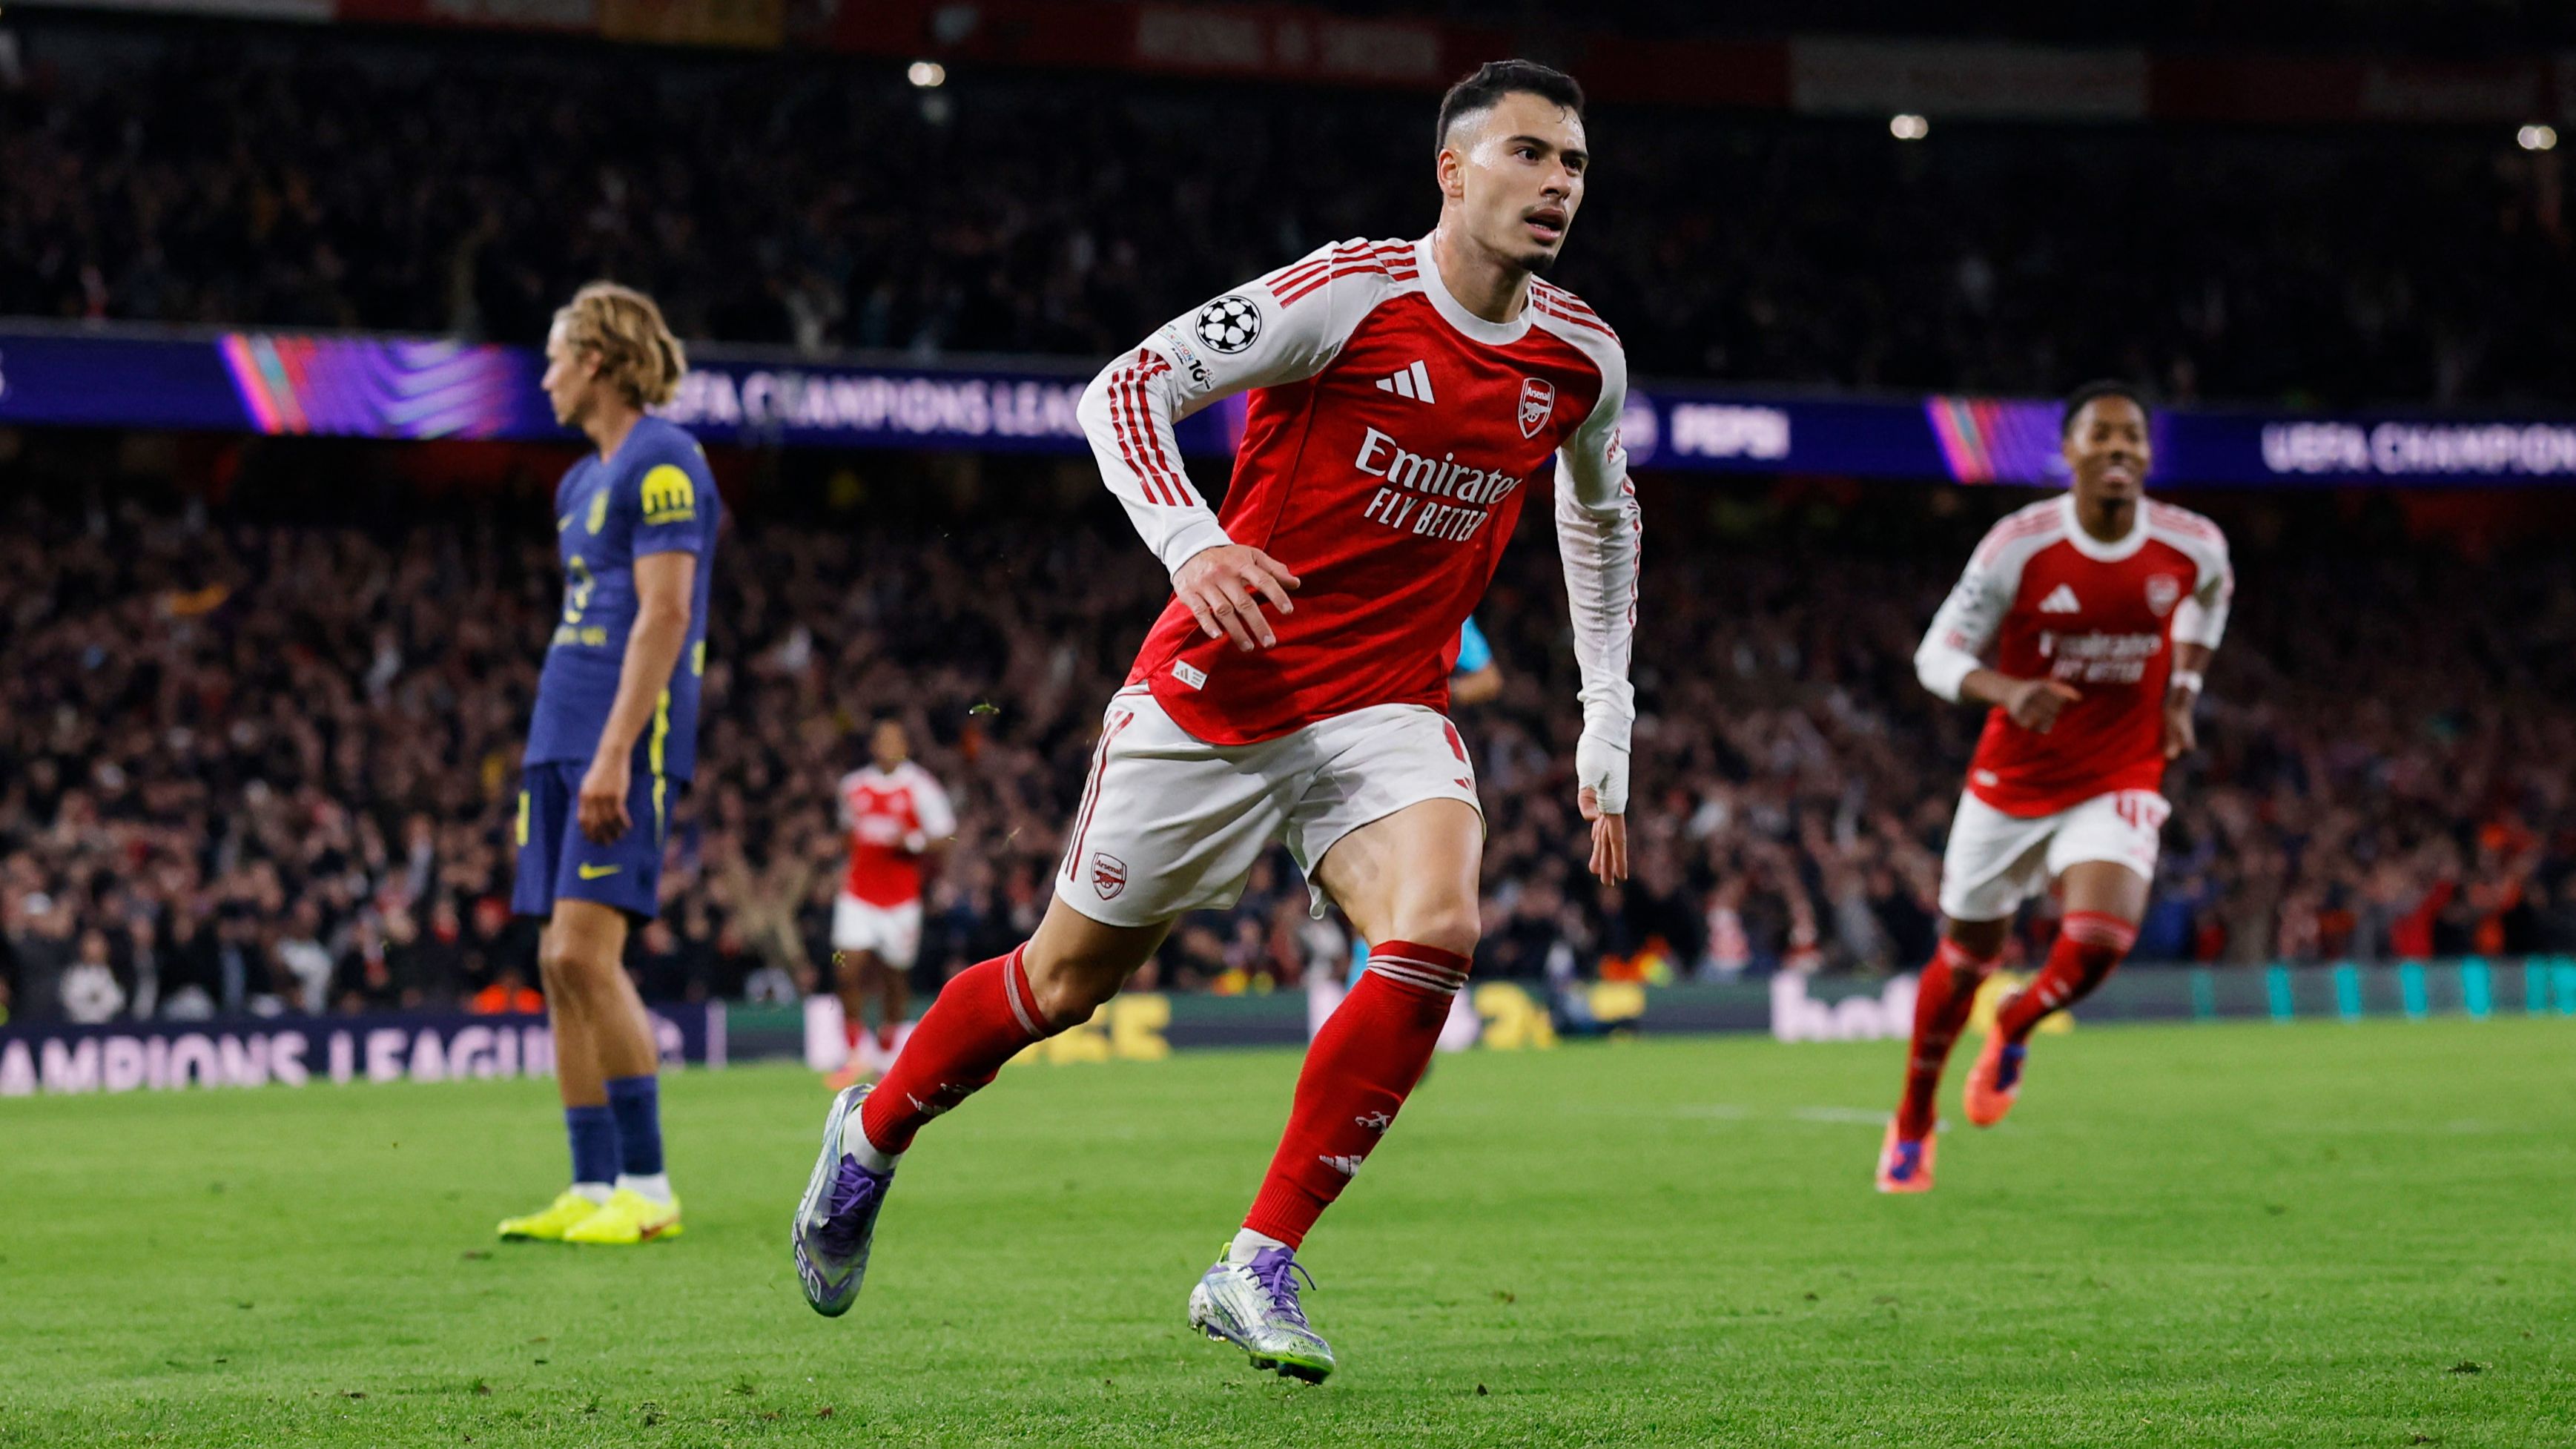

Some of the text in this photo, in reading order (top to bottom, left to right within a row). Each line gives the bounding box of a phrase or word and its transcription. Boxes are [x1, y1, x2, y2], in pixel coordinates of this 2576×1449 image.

[1527, 386, 1550, 401] Arsenal
[1355, 426, 1522, 504] Emirate
[2261, 422, 2370, 475] UEFA
[1364, 487, 1488, 541] FLY BETTER
[1096, 859, 1122, 876] Arsenal
[328, 1025, 558, 1084] LEAGU
